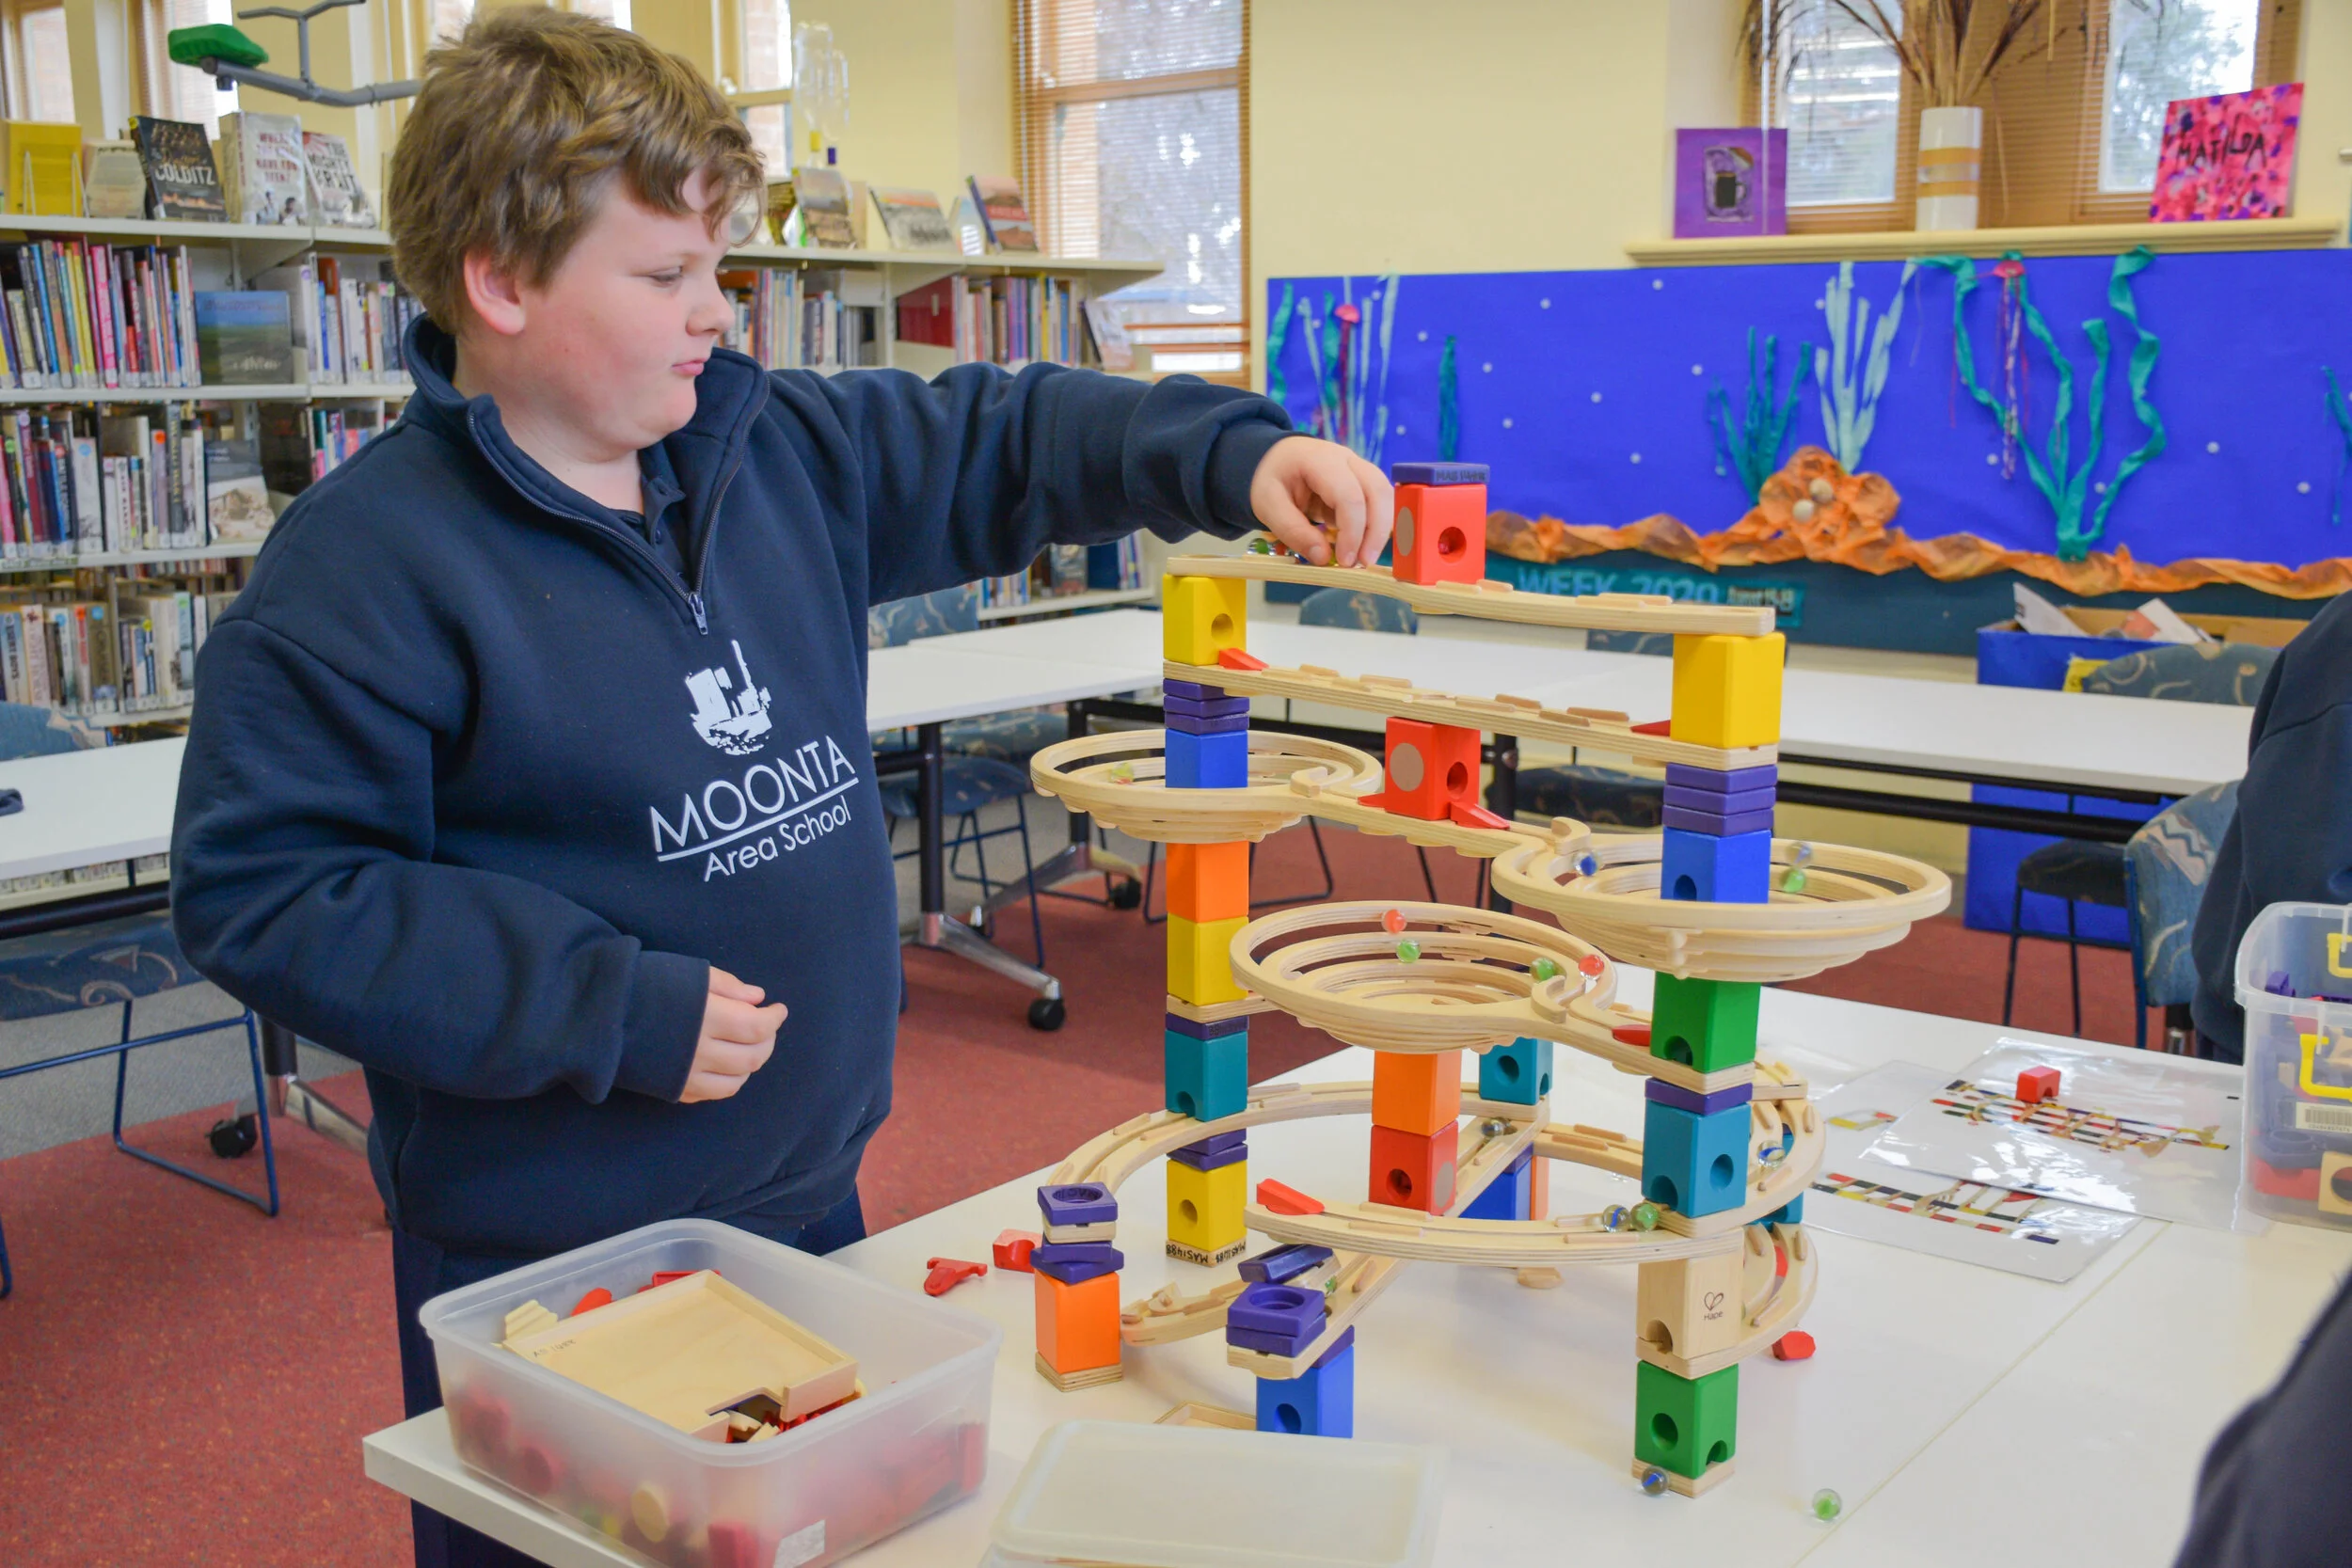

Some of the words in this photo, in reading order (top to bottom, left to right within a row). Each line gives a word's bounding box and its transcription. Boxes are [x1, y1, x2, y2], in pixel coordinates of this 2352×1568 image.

[2176, 114, 2267, 172] MATILDA
[154, 163, 217, 185] COLDITZ
[1518, 567, 1617, 596] WEEK
[1631, 574, 1720, 603] 2020
[650, 735, 856, 853] MOONTA
[705, 836, 779, 882] Area
[779, 795, 852, 850] School
